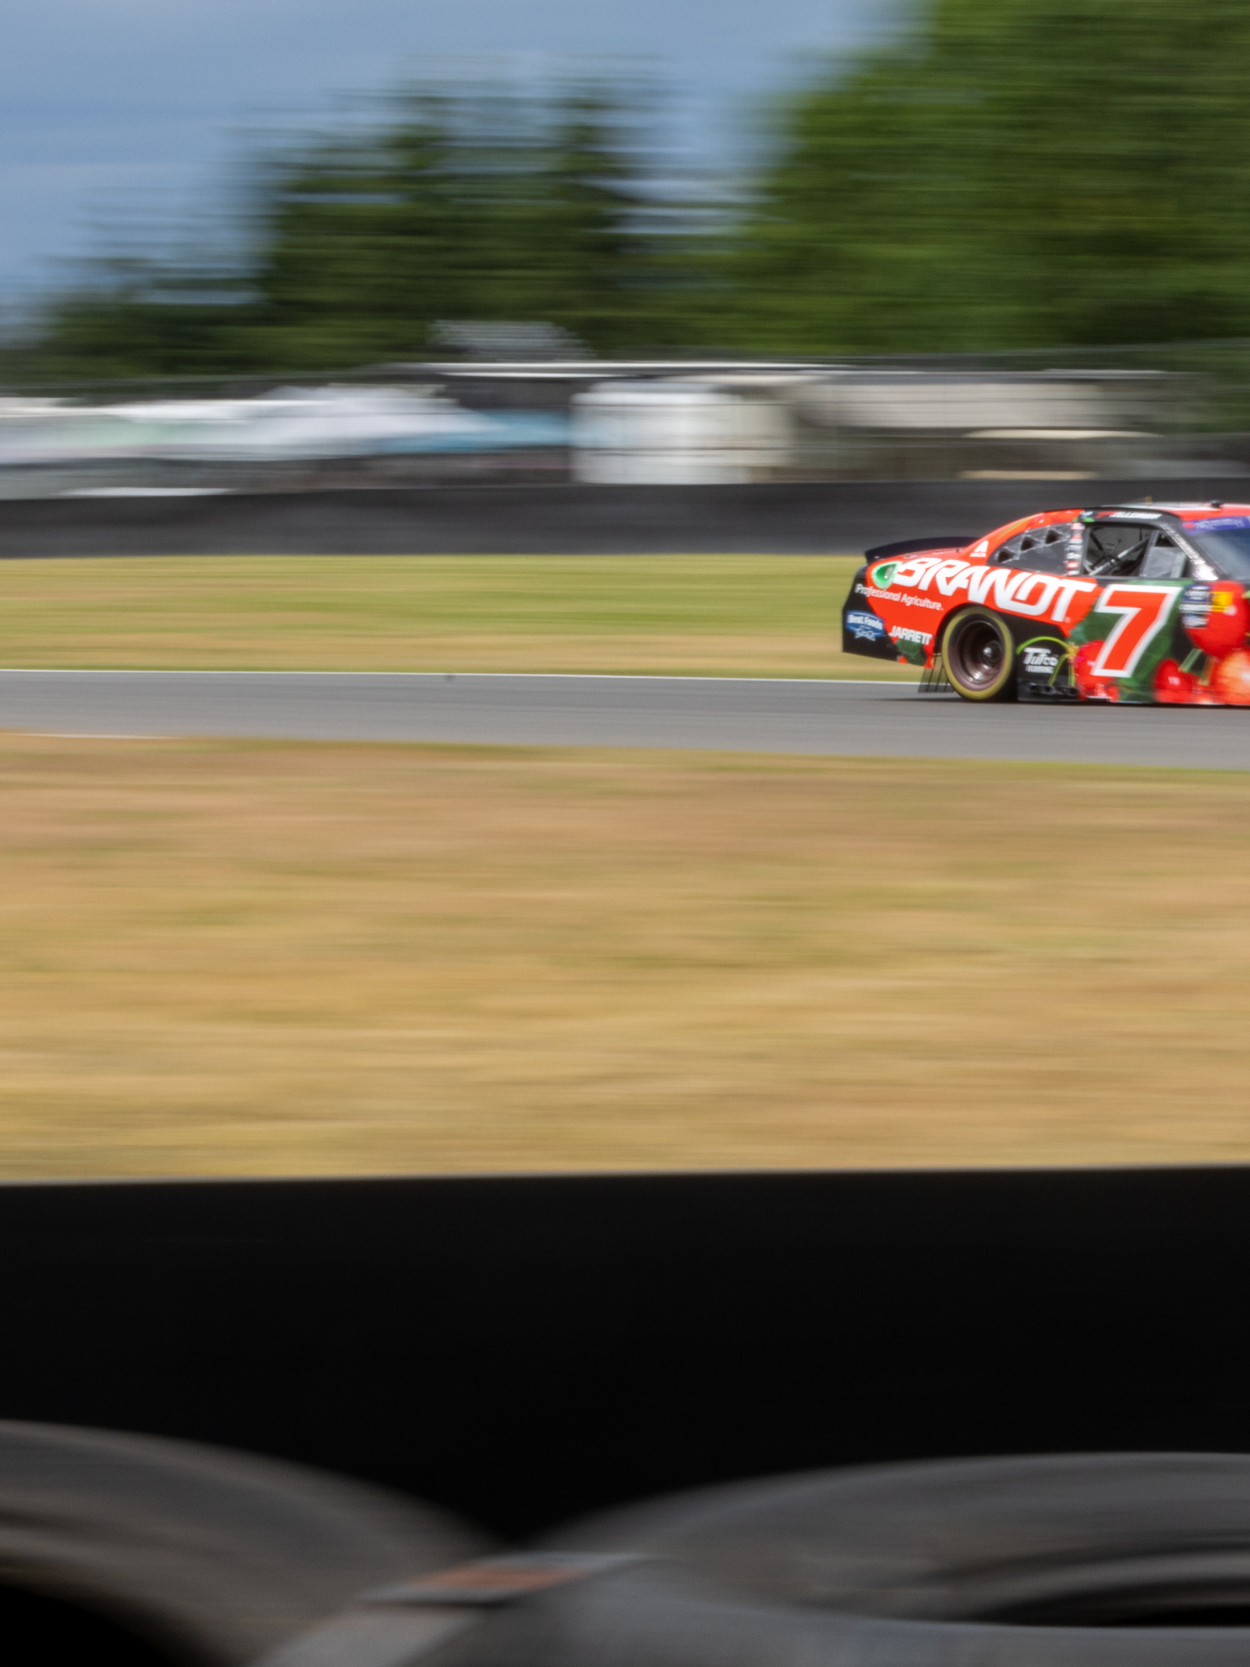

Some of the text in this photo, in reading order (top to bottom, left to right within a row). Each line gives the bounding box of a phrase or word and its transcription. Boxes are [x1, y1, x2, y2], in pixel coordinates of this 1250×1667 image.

[855, 583, 901, 601] Professional
[891, 557, 1098, 622] BRANDT
[888, 625, 933, 645] JARRETT
[1090, 584, 1184, 679] 7
[1023, 647, 1059, 667] Tufco
